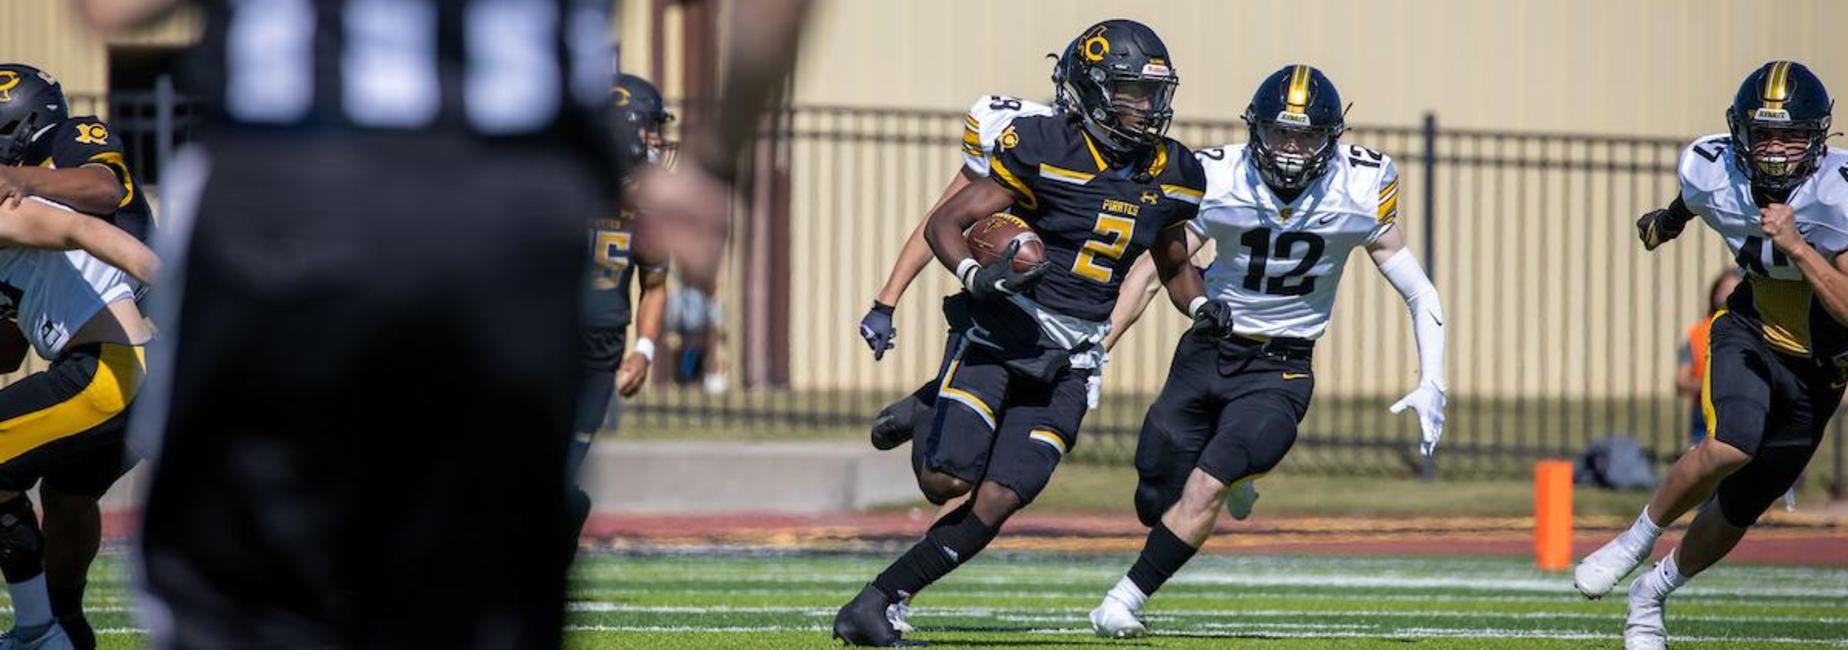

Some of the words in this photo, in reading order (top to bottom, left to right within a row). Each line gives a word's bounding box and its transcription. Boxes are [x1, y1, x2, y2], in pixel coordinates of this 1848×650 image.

[1195, 148, 1224, 161] 2
[1349, 145, 1382, 168] 12
[1693, 138, 1728, 163] 7
[1102, 199, 1140, 217] PIRATES
[1070, 213, 1136, 282] 2
[591, 231, 632, 290] 5
[1241, 227, 1325, 296] 12
